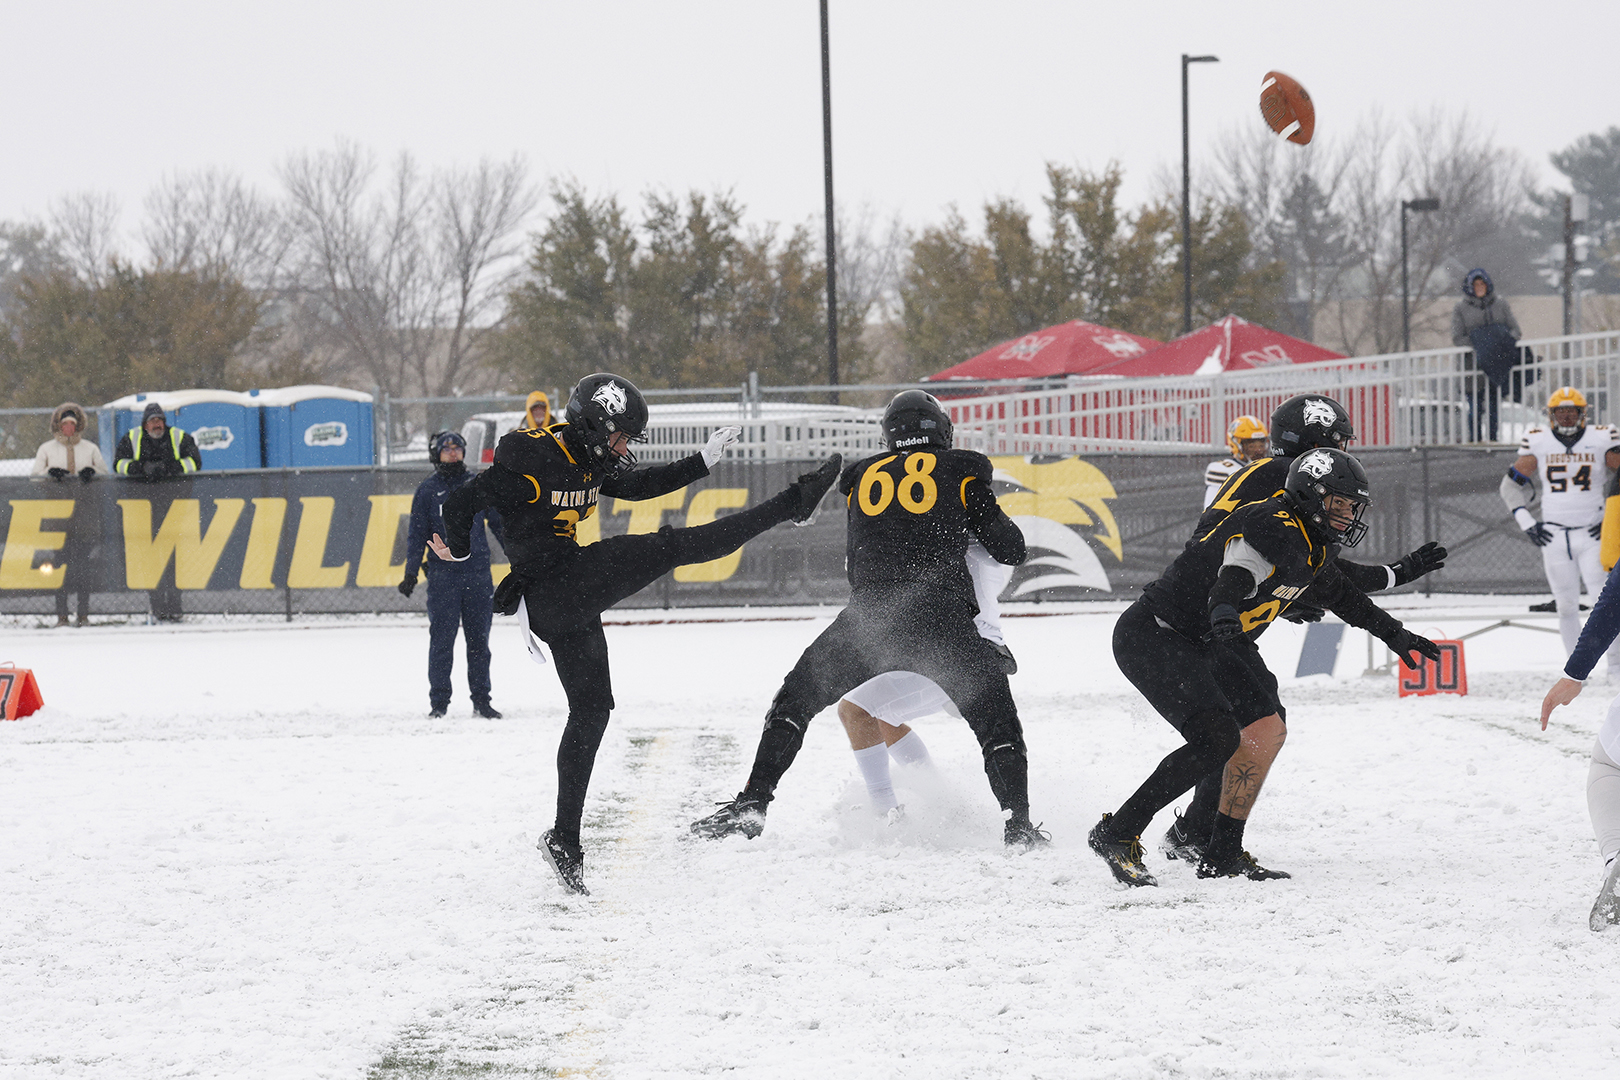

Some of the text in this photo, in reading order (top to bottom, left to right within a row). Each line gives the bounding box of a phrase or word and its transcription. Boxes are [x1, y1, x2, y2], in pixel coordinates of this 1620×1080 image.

[895, 436, 930, 448] Riddell
[857, 451, 938, 517] 68
[1546, 464, 1592, 494] 54
[551, 490, 586, 507] WAYNE
